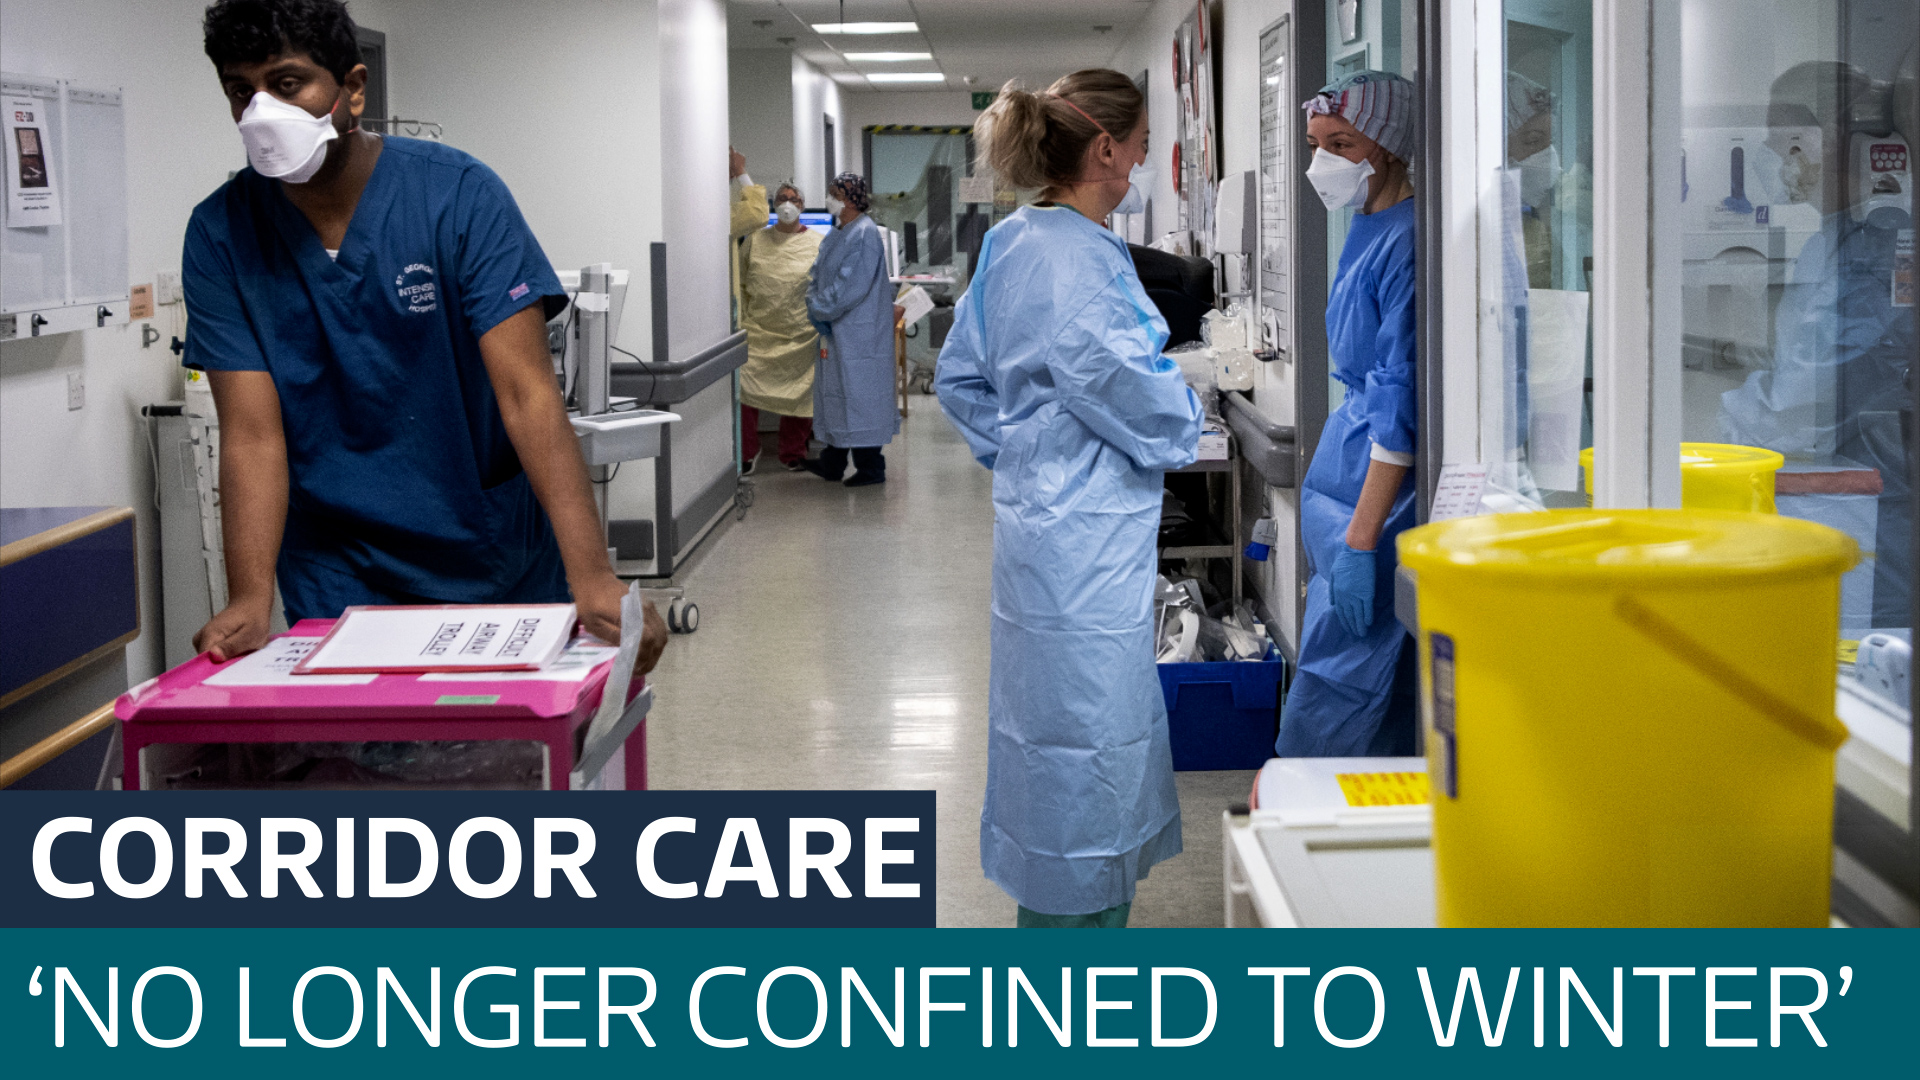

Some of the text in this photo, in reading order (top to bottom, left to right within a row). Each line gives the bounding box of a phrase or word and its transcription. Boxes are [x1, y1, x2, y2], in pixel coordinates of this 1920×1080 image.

[425, 622, 465, 656] TROLLEY
[465, 622, 501, 655] AIRWAY
[501, 618, 541, 657] DIFFICULT
